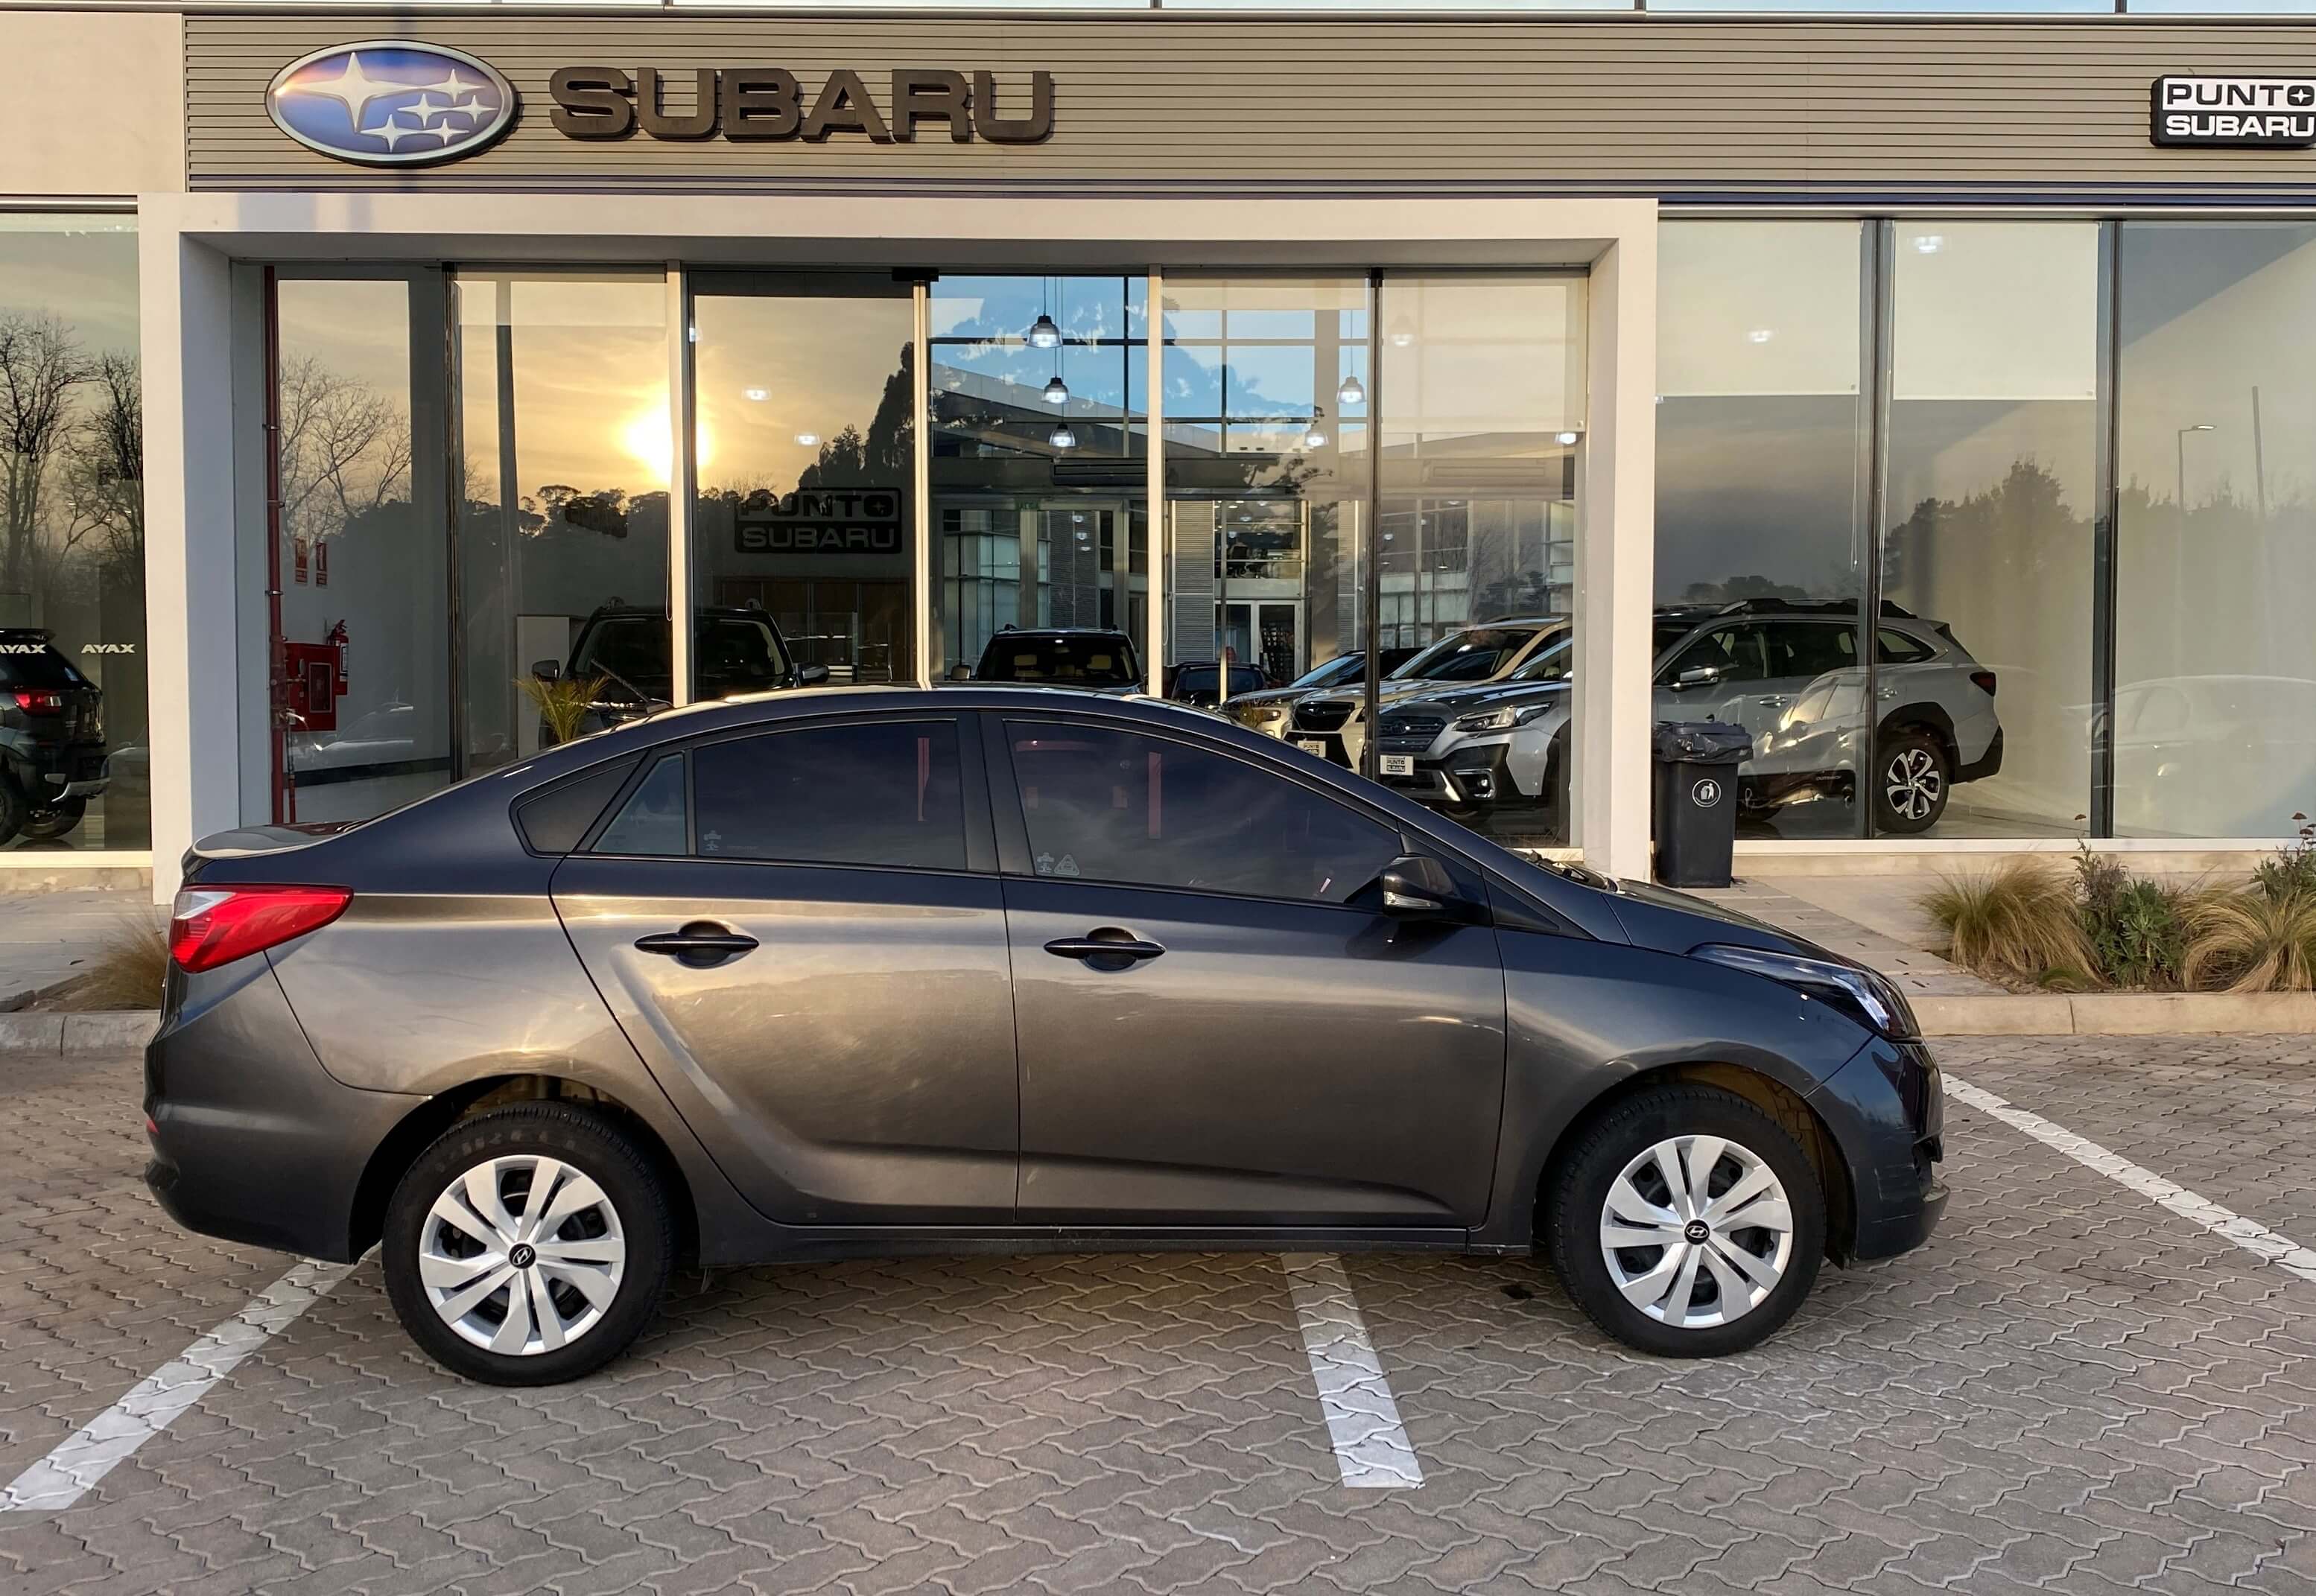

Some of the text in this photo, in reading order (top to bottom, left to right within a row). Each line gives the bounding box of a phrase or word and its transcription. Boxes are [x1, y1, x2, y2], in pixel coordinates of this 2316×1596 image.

[549, 66, 1052, 144] SUBARU
[2167, 84, 2315, 106] PUNTO
[2166, 115, 2315, 137] SUBARU
[740, 495, 894, 517] PUNTO
[742, 527, 894, 548] SUBARU
[81, 643, 136, 654] AYAX
